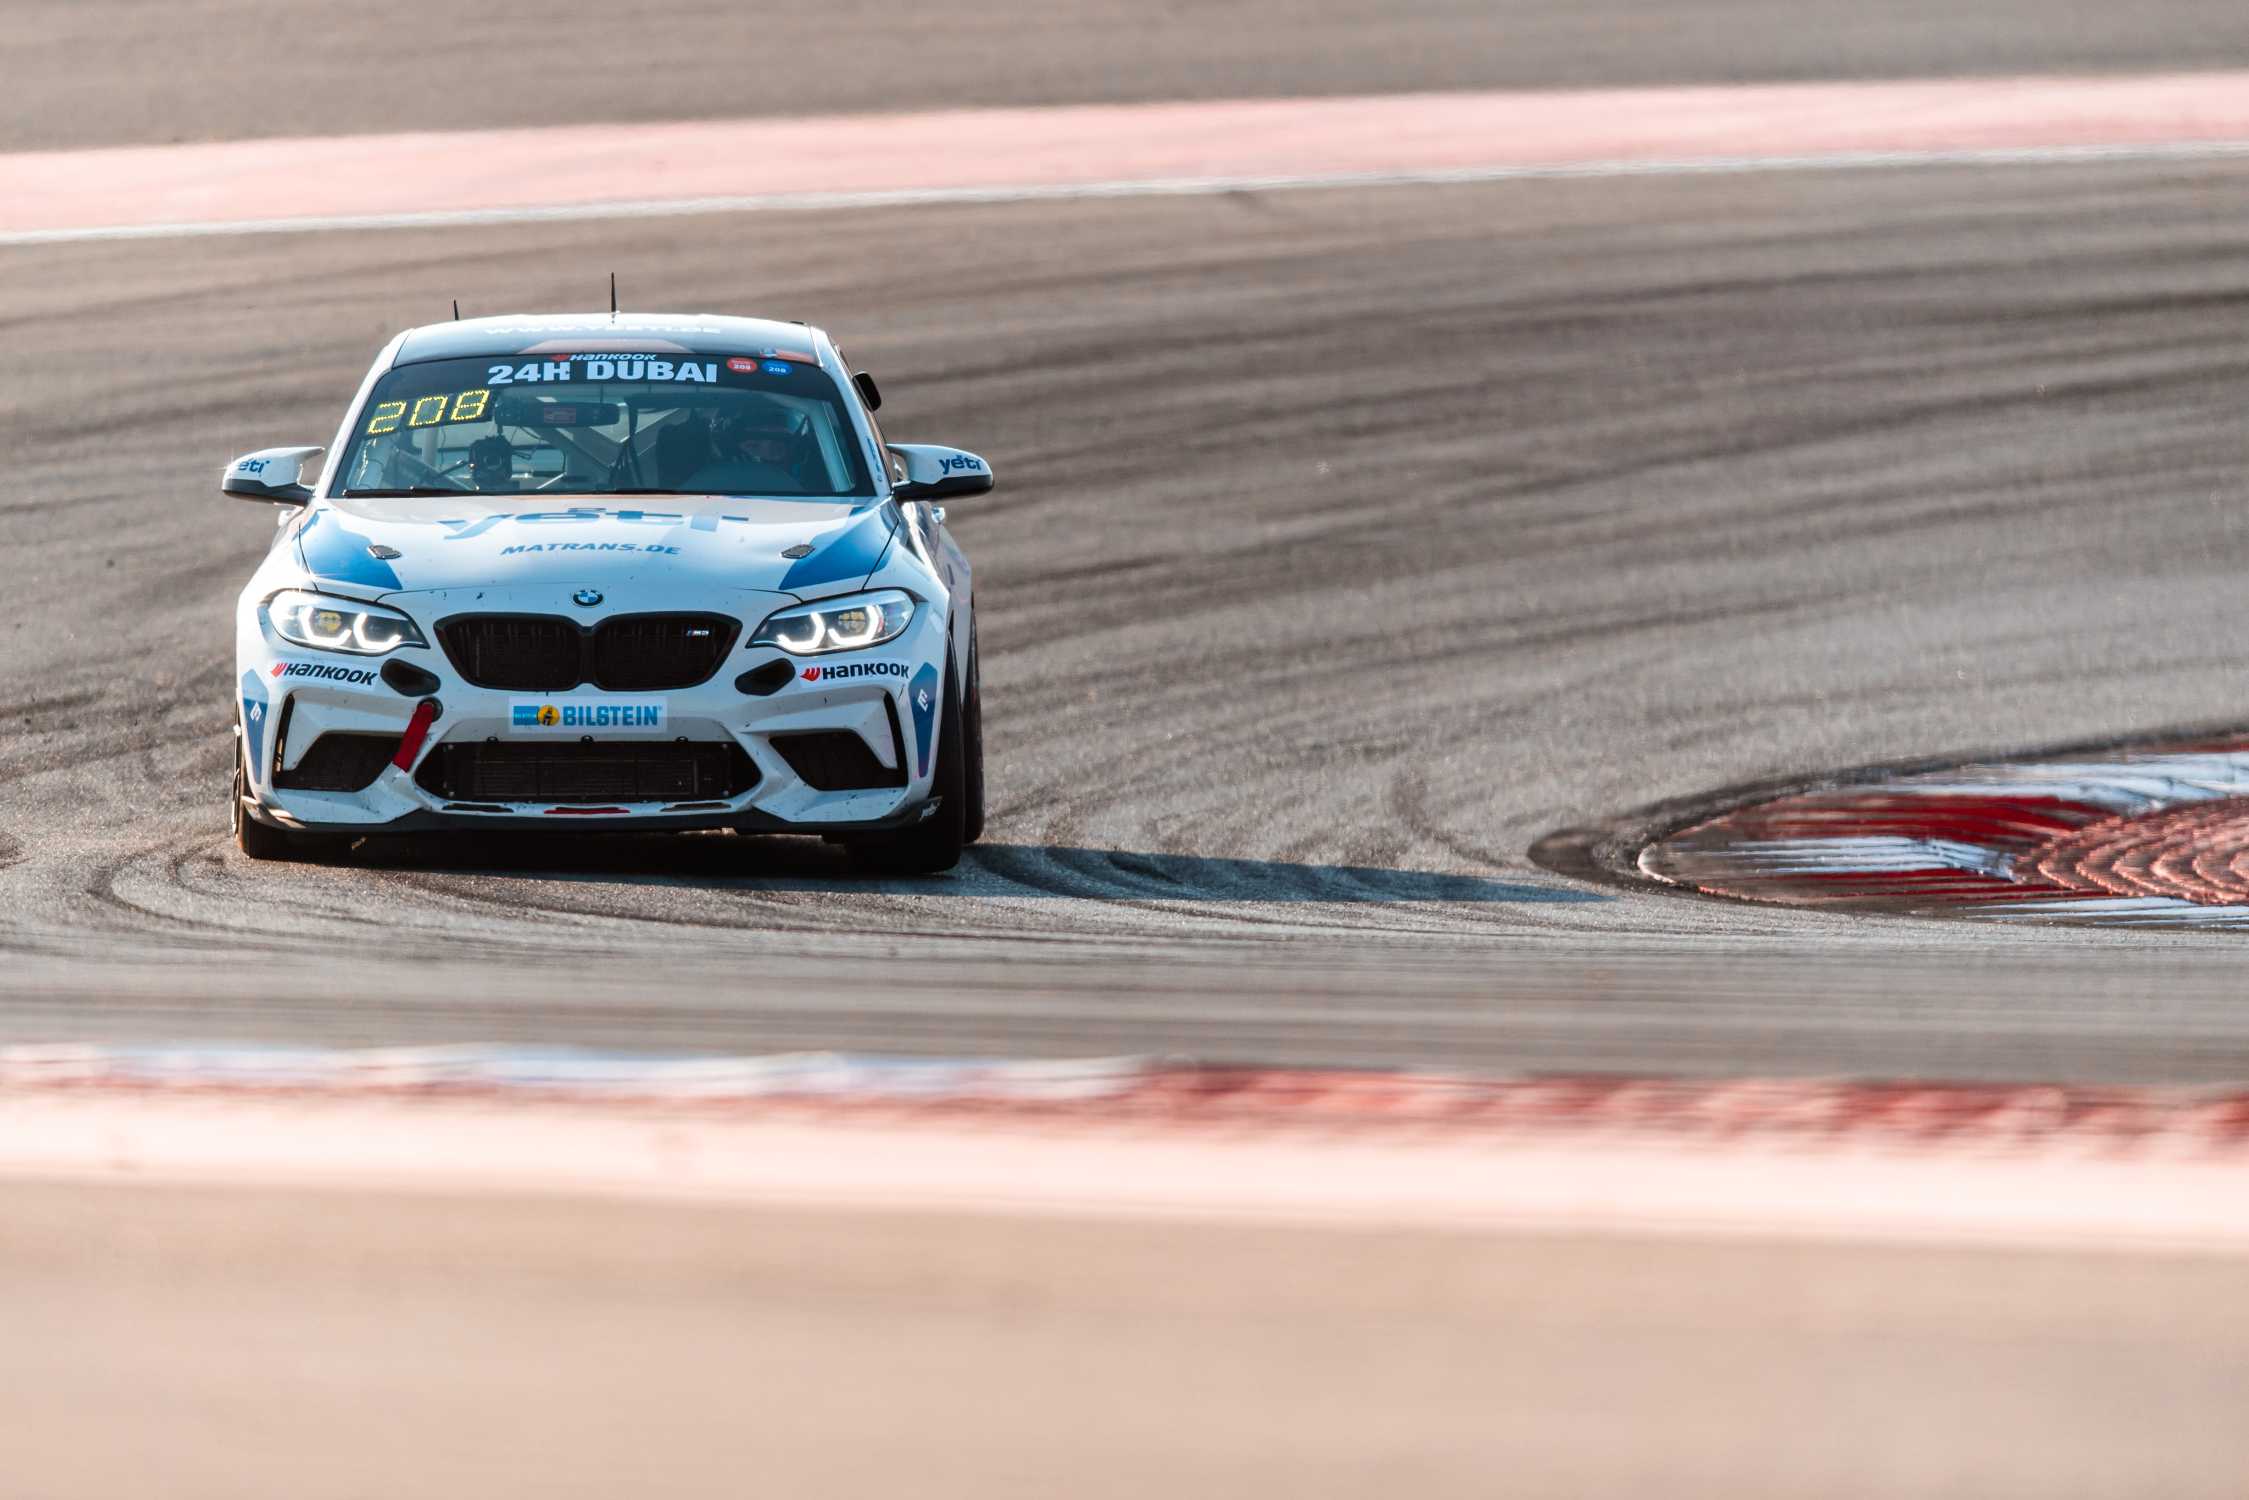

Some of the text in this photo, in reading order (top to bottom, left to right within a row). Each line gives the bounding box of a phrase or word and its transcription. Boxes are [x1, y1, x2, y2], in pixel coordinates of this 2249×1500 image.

[487, 361, 718, 385] 24H DUBAI
[367, 389, 490, 434] 208
[237, 458, 271, 474] eti
[500, 542, 683, 556] MATRANS.DE
[562, 705, 659, 726] BILSTEIN
